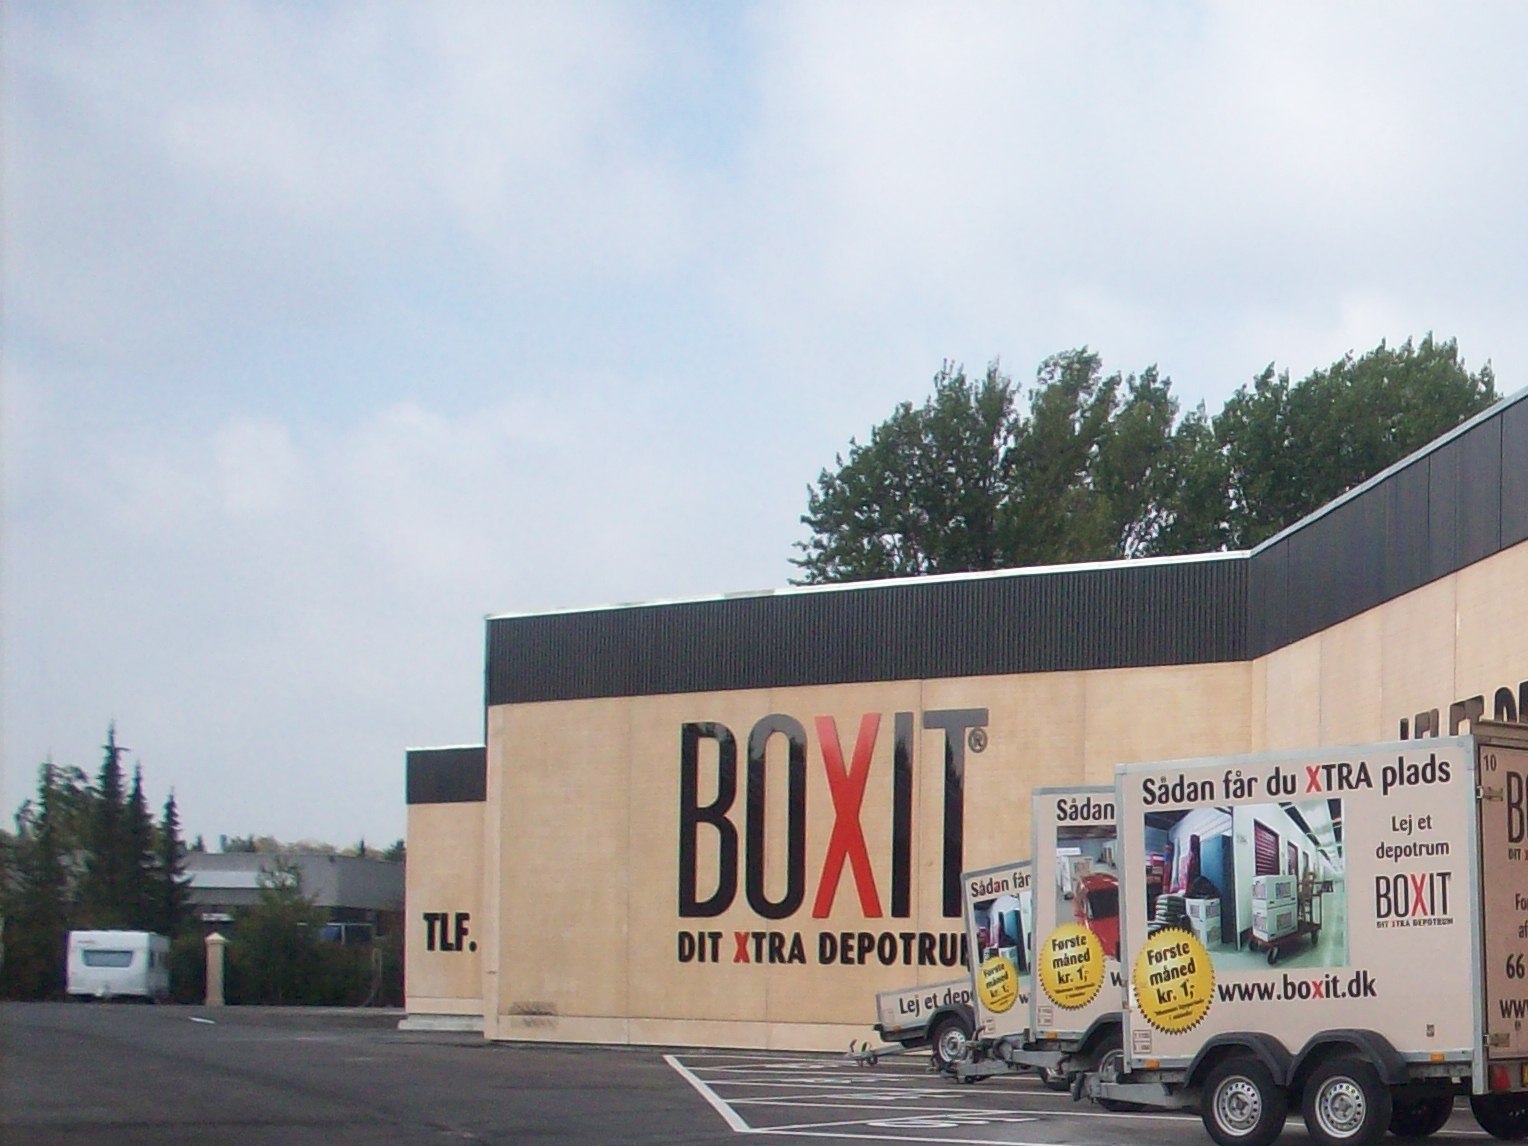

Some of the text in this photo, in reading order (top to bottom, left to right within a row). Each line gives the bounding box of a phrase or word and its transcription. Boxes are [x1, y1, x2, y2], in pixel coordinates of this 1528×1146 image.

[1483, 754, 1497, 771] 10
[1142, 753, 1451, 805] Sådan får du XTRA plads
[1057, 797, 1114, 821] Sådan
[1392, 814, 1432, 835] Lej et
[1376, 841, 1449, 862] depotrum
[971, 878, 1009, 898] Sådan
[1375, 872, 1451, 918] BOXIT
[423, 912, 477, 952] TLF.
[678, 931, 723, 963] DIT
[733, 931, 806, 964] XTRA
[1052, 948, 1091, 969] måned
[1058, 971, 1074, 984] kr.
[1150, 957, 1196, 986] måned
[1506, 953, 1525, 979] 66
[1156, 988, 1177, 1004] kr.
[1218, 970, 1377, 1002] www.boxit.dk
[899, 994, 920, 1017] Lej
[925, 993, 940, 1009] et
